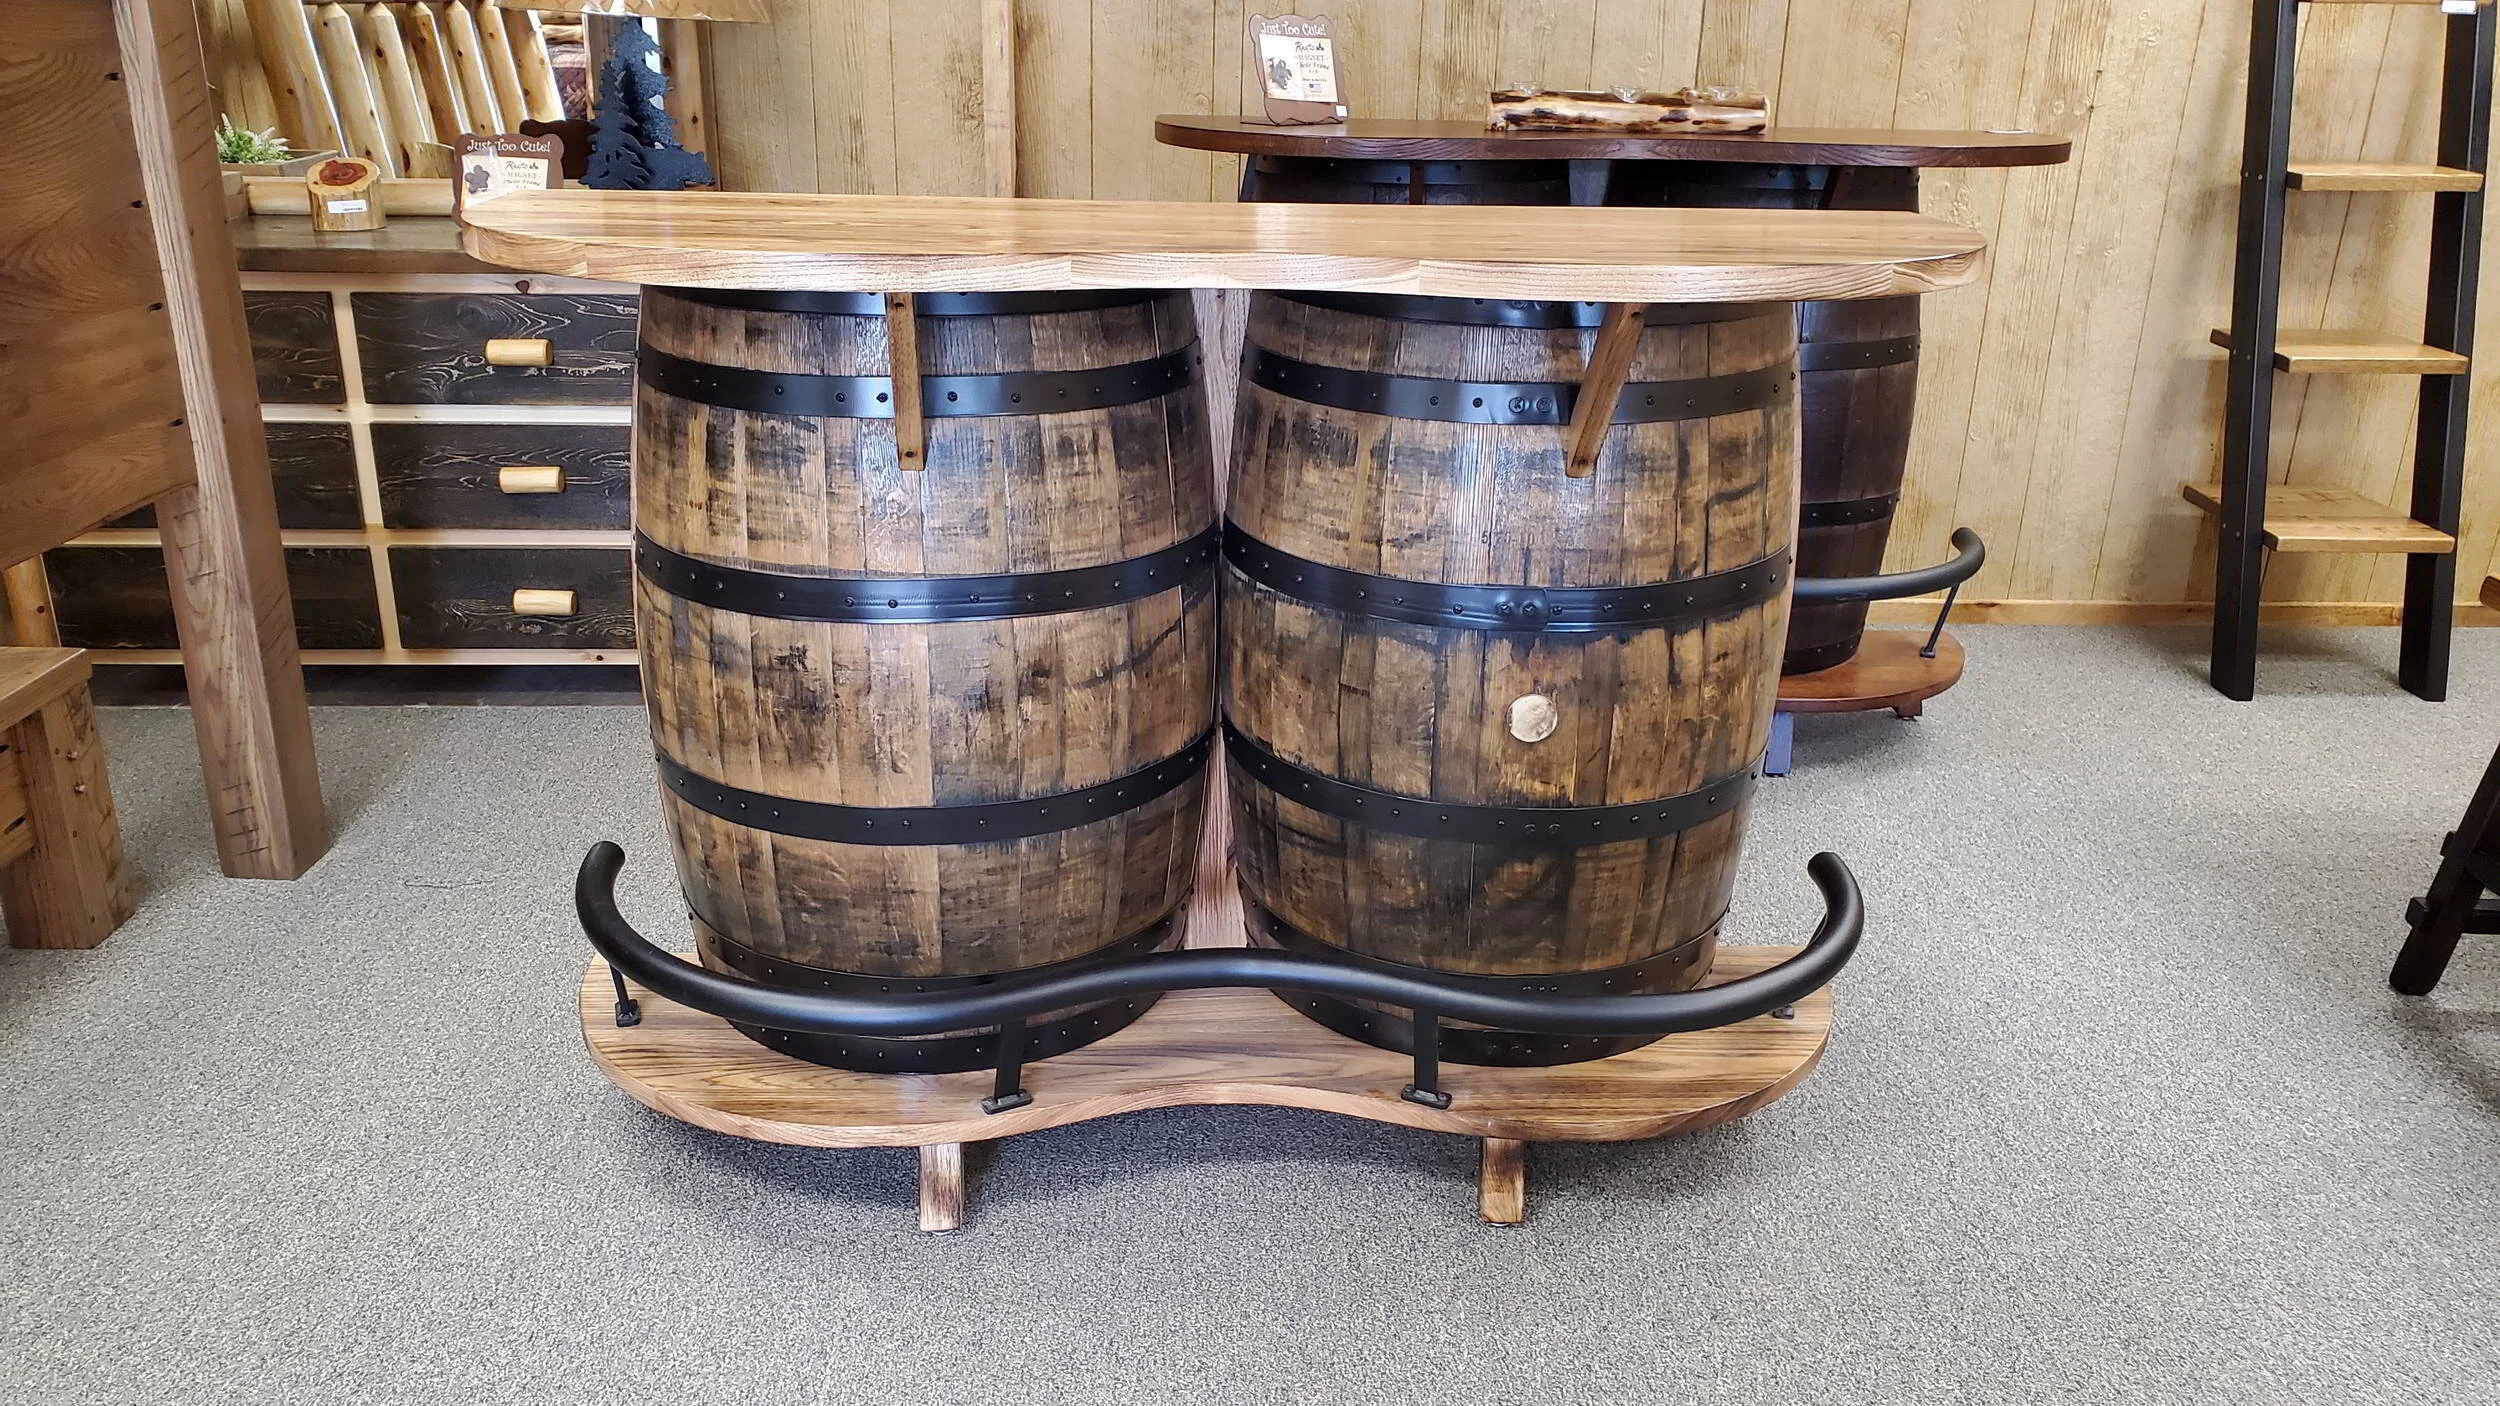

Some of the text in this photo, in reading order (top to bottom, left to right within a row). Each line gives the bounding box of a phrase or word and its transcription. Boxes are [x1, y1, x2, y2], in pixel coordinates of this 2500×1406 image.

[1261, 21, 1327, 37] Just Too Cute!
[467, 138, 551, 153] Just Too Cute!
